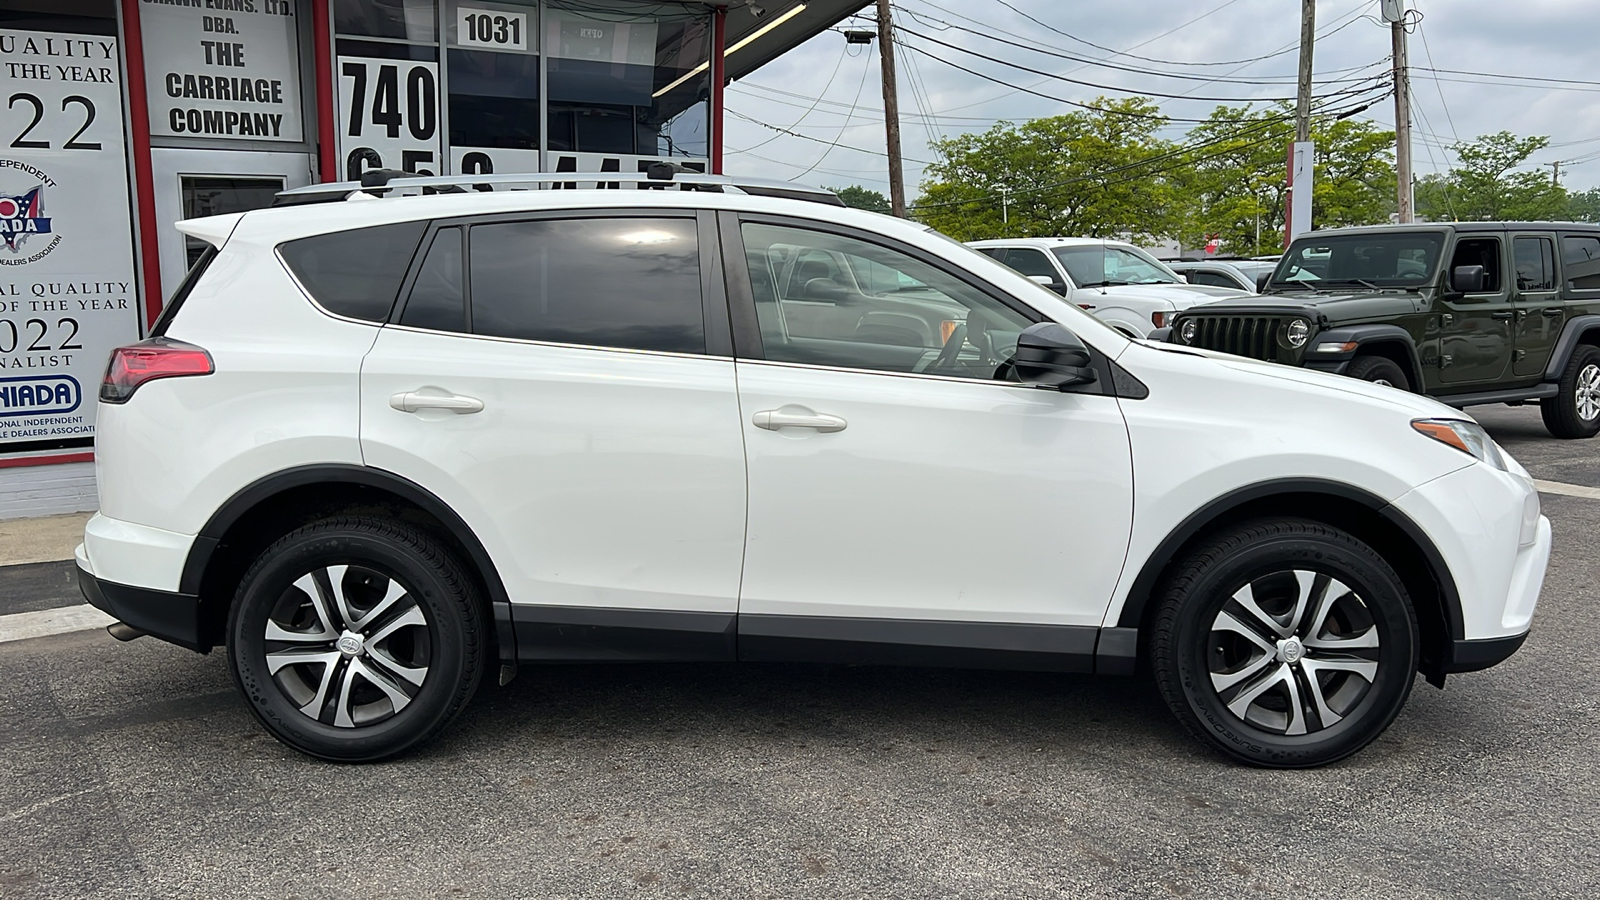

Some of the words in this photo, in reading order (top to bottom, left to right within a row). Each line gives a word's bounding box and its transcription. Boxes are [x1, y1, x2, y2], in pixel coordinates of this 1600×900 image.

[264, 0, 294, 17] LTD.
[202, 15, 240, 35] DBA.
[464, 13, 520, 45] 1031
[200, 40, 246, 67] THE
[5, 62, 52, 80] THE
[56, 65, 114, 84] YEAR
[165, 72, 283, 104] CARRIAGE
[342, 62, 436, 141] 740
[8, 92, 103, 151] 22
[169, 107, 283, 137] COMPANY
[0, 258, 27, 266] EALERS
[31, 282, 129, 298] QUALITY
[28, 300, 69, 311] THE
[78, 298, 129, 310] YEAR
[24, 416, 83, 427] INDEPENDENT
[11, 428, 48, 438] DEALERS
